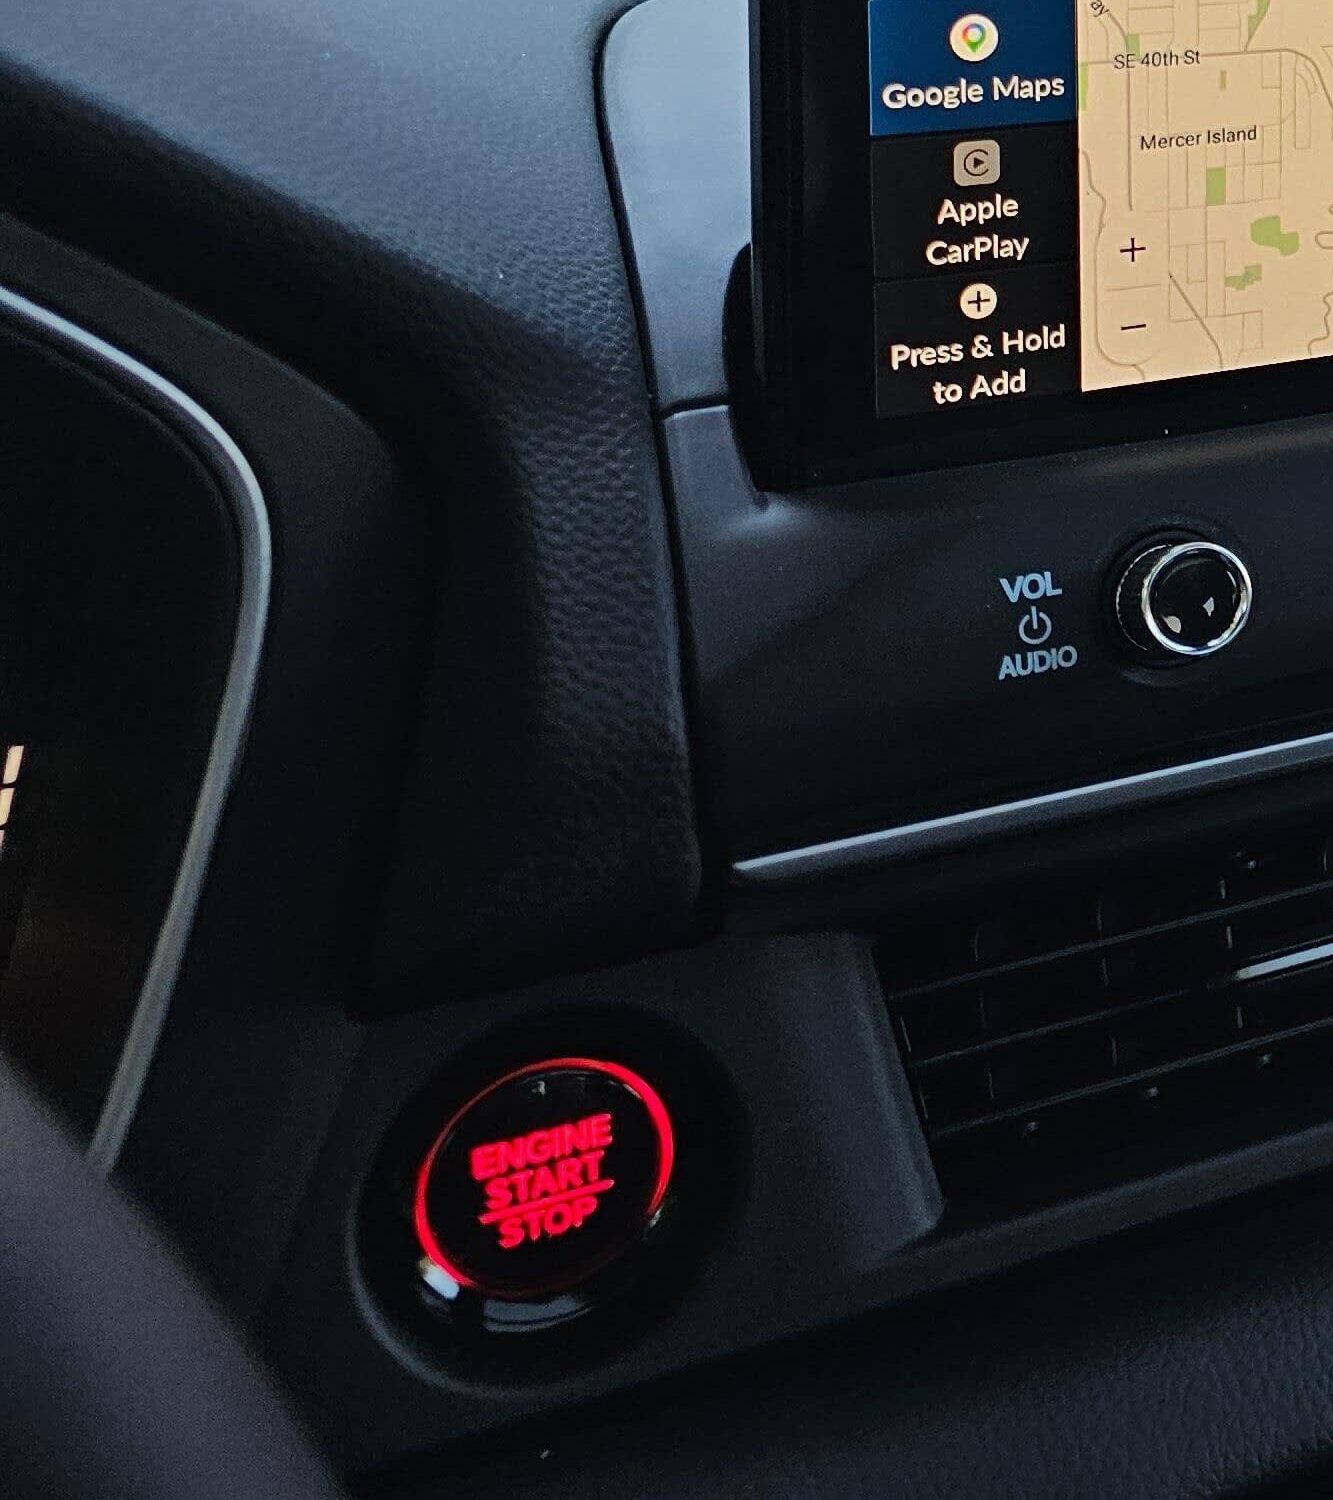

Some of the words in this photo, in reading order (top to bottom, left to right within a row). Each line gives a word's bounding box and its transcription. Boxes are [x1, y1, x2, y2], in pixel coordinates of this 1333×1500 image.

[1114, 53, 1137, 70] SE
[1140, 50, 1179, 67] 40th
[1183, 49, 1201, 65] St
[882, 78, 984, 110] Google
[992, 74, 1065, 104] Maps
[1140, 131, 1202, 151] Mercer
[1206, 125, 1258, 145] Island
[937, 194, 1019, 227] Apple
[925, 235, 1030, 266] CarPlay
[891, 339, 964, 371] Press
[971, 334, 994, 358] &
[1002, 324, 1066, 355] Hold
[932, 378, 963, 405] to
[969, 369, 1027, 399] Add
[999, 571, 1062, 603] VOL
[998, 645, 1078, 680] AUDIO
[470, 1113, 613, 1182] ENGINE
[485, 1150, 604, 1211] START
[498, 1196, 598, 1249] STOP
